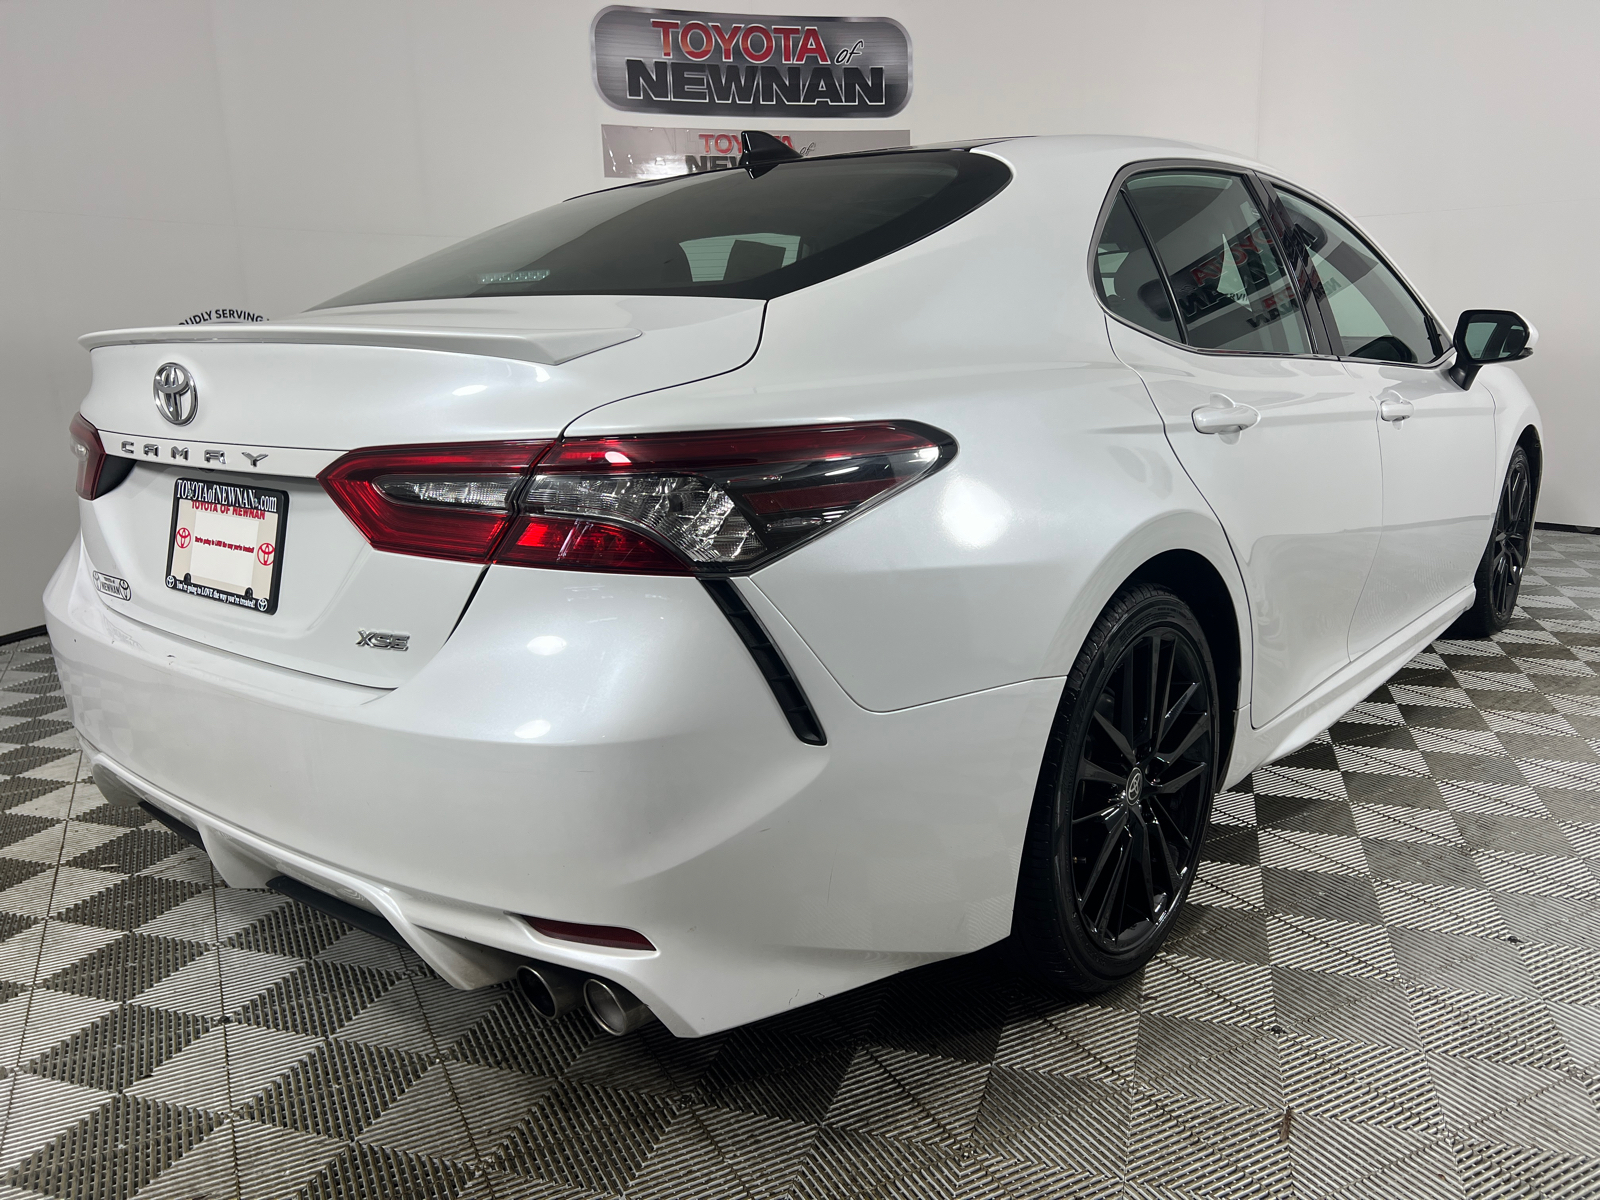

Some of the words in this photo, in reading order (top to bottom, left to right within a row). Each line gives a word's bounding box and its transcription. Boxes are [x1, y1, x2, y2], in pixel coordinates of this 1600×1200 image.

[651, 19, 830, 64] TOYOTA
[835, 40, 863, 65] of
[626, 58, 885, 105] NEWNAN
[214, 309, 264, 322] SERVING
[121, 441, 268, 468] CAMRY
[191, 500, 218, 513] TOYOTA
[220, 505, 230, 515] OF
[232, 507, 266, 520] NEWNAN
[355, 630, 410, 651] XSE
